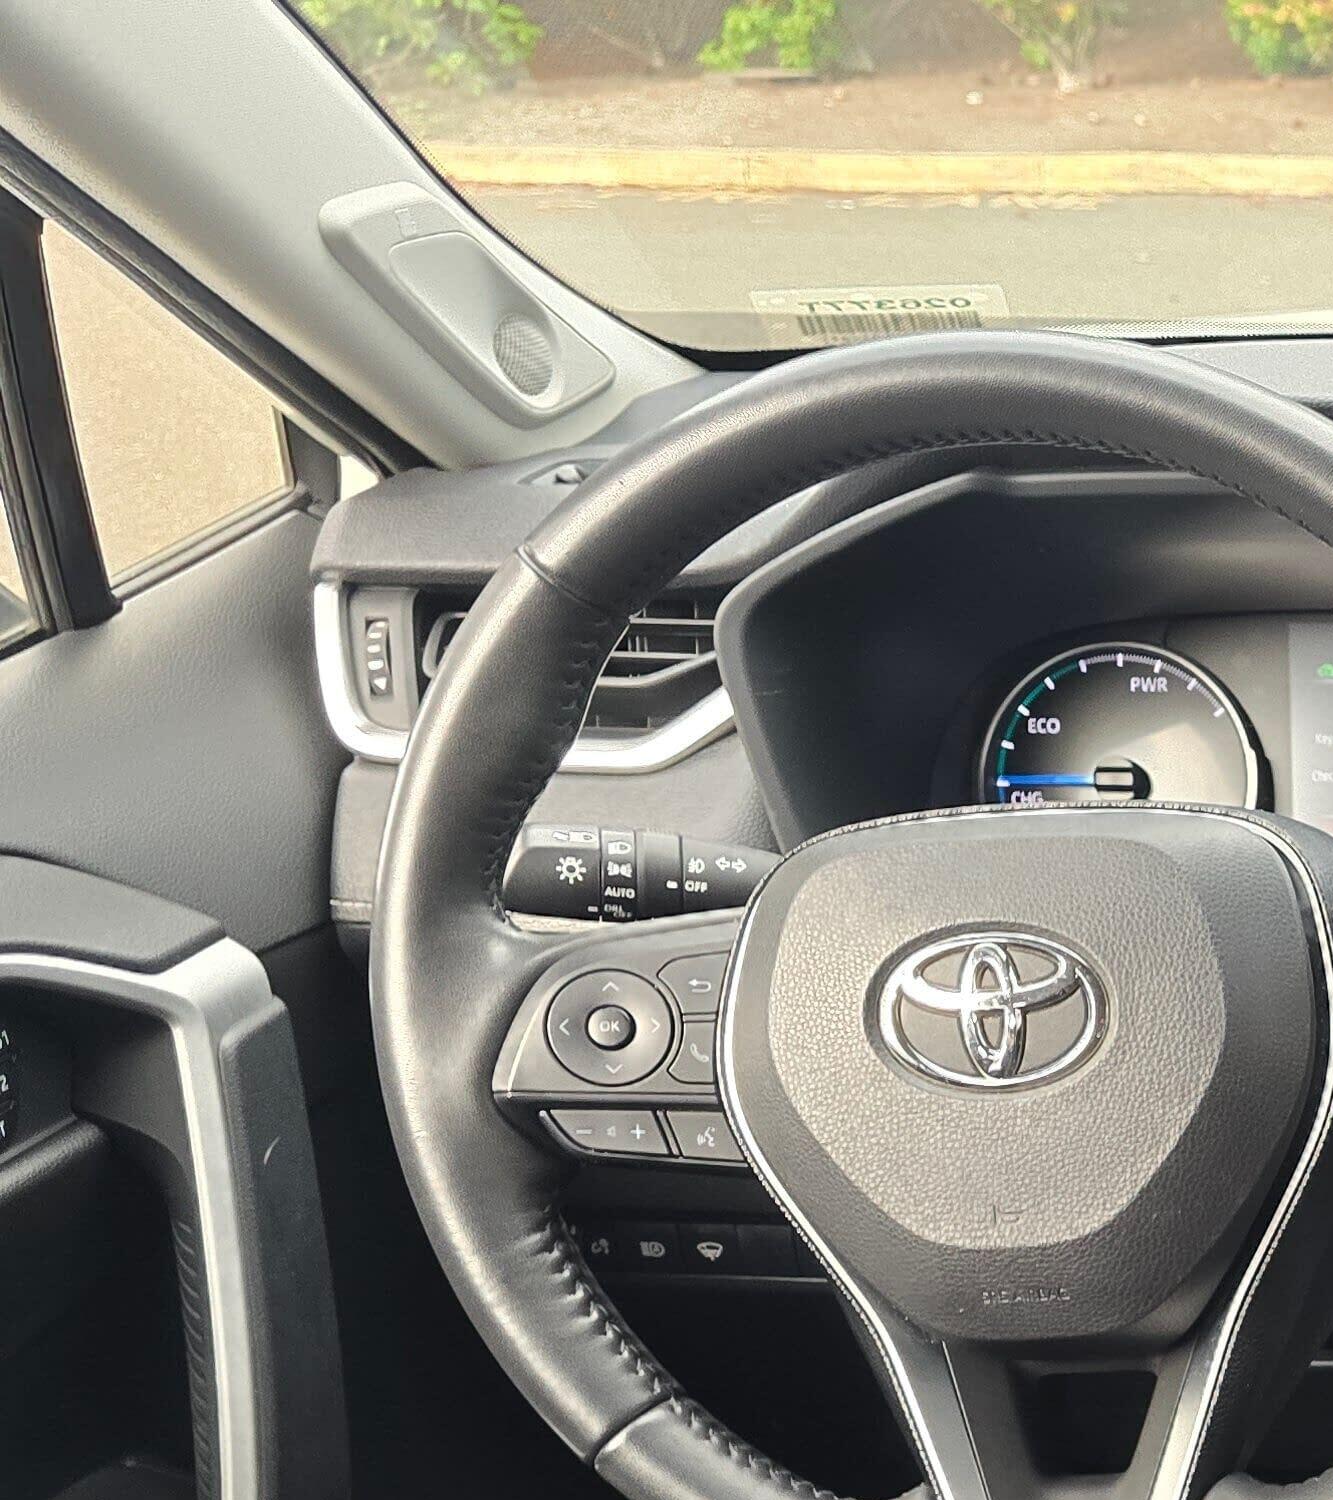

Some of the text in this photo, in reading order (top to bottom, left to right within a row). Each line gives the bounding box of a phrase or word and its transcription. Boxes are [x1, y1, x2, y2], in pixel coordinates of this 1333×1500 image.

[1129, 676, 1169, 693] PWR
[1027, 716, 1062, 735] ECO
[604, 886, 636, 899] AUTO
[684, 880, 708, 894] OFF
[599, 1020, 621, 1034] OK
